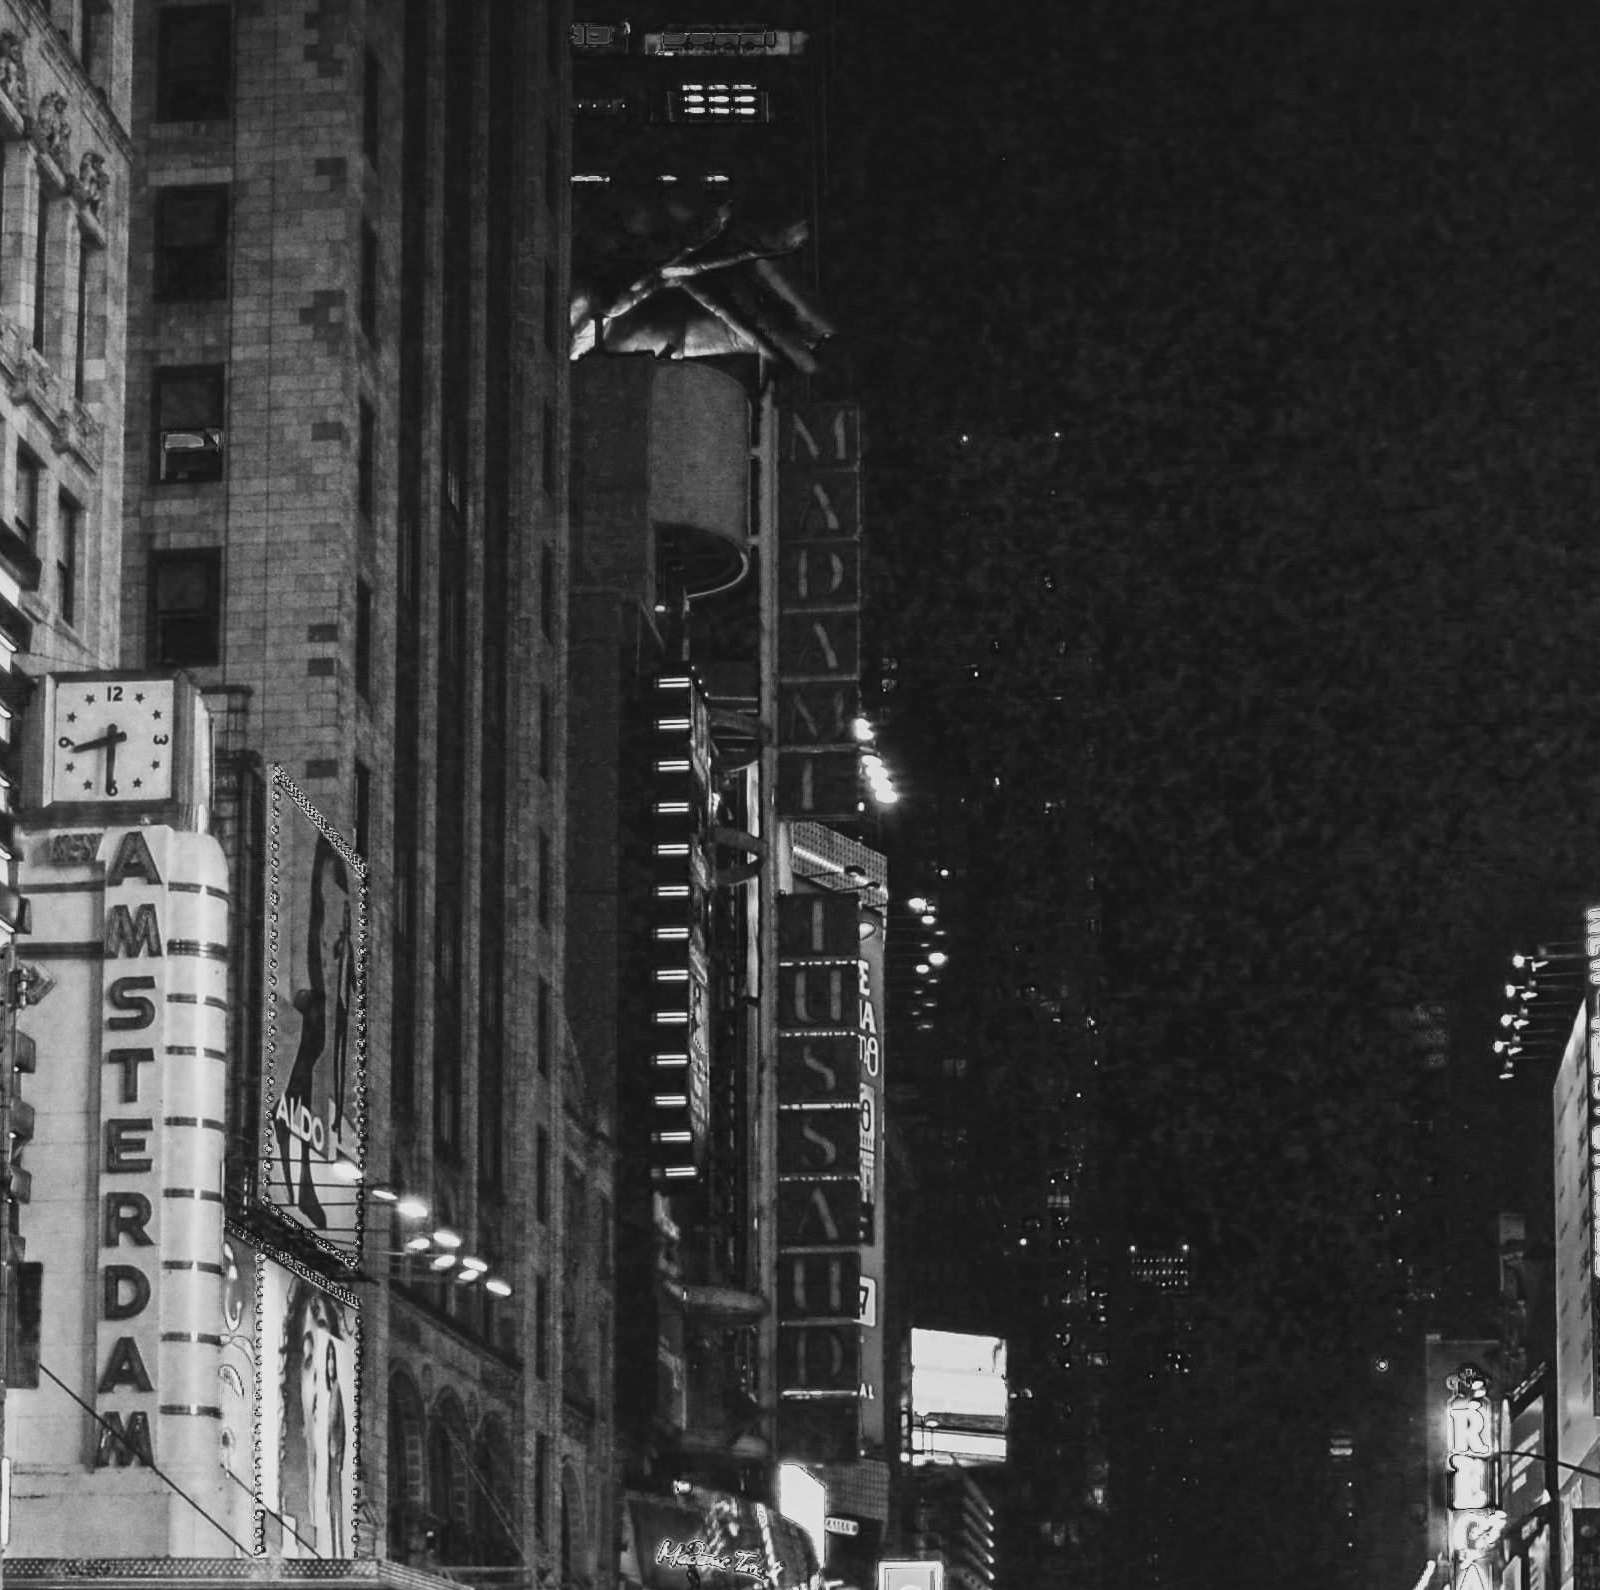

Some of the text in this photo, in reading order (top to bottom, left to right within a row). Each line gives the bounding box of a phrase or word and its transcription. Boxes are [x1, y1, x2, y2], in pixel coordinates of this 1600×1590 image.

[106, 685, 124, 702] 12
[152, 733, 170, 746] 3
[275, 1092, 325, 1151] ALDO
[99, 829, 164, 1469] AMSTERDAM
